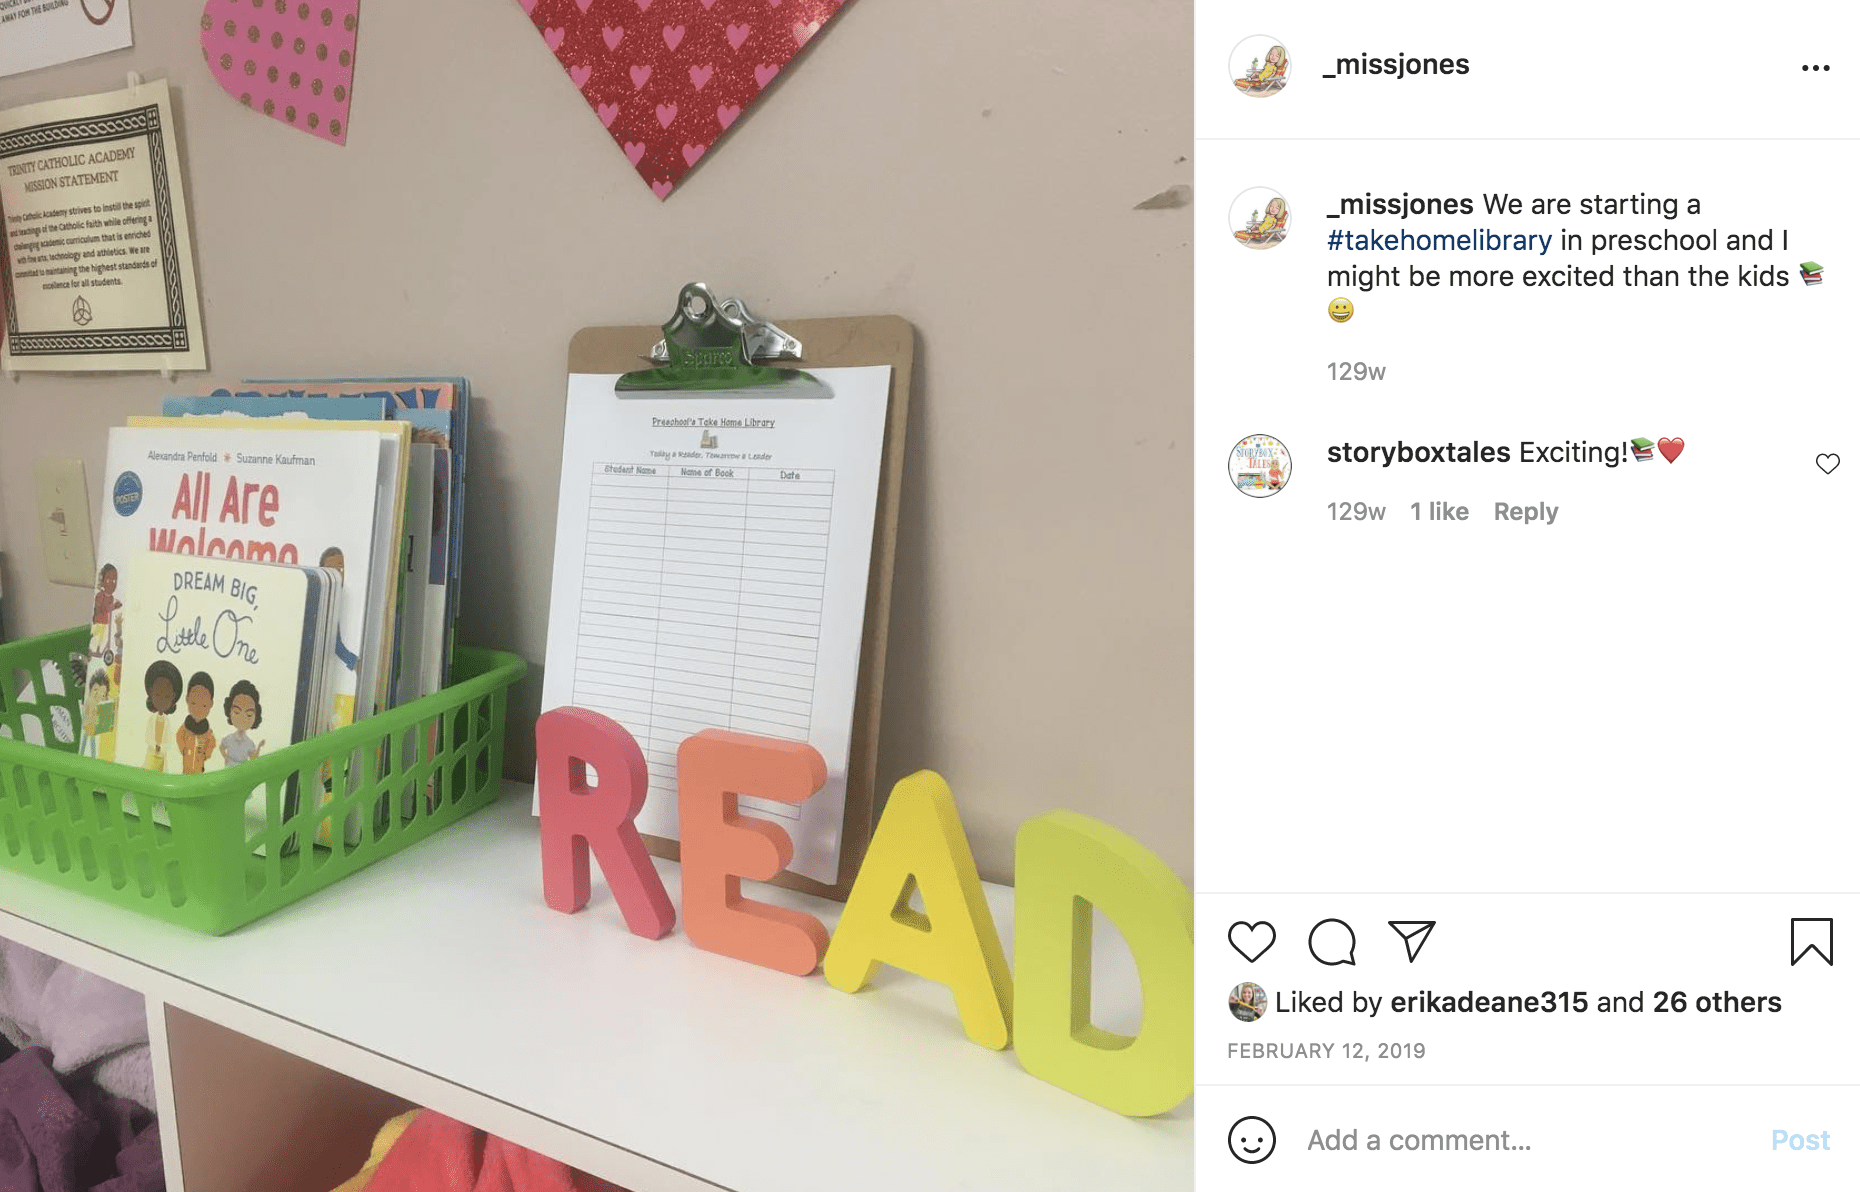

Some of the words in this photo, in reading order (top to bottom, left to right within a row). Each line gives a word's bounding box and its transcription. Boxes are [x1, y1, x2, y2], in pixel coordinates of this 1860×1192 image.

[31, 5, 42, 15] THE
[42, 0, 69, 12] BUILDING
[7, 161, 36, 177] TRINITY
[38, 154, 85, 171] CATHOLIC
[88, 147, 136, 165] ACADEMY
[24, 177, 58, 193] MISSION
[59, 170, 119, 188] STATEMENT
[23, 210, 42, 221] Catholic
[43, 208, 67, 218] Academy
[69, 206, 92, 215] strives
[93, 204, 101, 213] to
[103, 201, 121, 212] instill
[123, 201, 133, 210] the
[134, 198, 151, 210] spirit
[19, 226, 41, 237] teachings
[42, 224, 47, 233] of
[48, 224, 58, 232] the
[59, 221, 85, 231] Catholic
[86, 219, 102, 229] faith
[103, 216, 121, 227] while
[123, 215, 147, 226] offering
[14, 242, 39, 252] challenging
[41, 239, 65, 248] academic
[66, 235, 100, 245] curriculum
[101, 233, 115, 242] that
[116, 232, 123, 241] is
[124, 230, 151, 240] enriched
[17, 256, 26, 264] with
[27, 255, 36, 263] fine
[49, 251, 81, 262] technology
[83, 248, 95, 258] and
[97, 247, 127, 257] athletics.
[128, 246, 139, 254] We
[140, 246, 150, 254] are
[39, 267, 45, 275] to
[46, 266, 78, 277] maintaining
[79, 265, 90, 273] the
[91, 263, 117, 275] highest
[119, 260, 149, 271] standards
[150, 258, 158, 268] of
[43, 281, 70, 290] excellence
[71, 279, 80, 289] for
[81, 278, 89, 288] all
[91, 276, 123, 287] students.
[685, 351, 733, 369] Sparco
[652, 417, 696, 427] Preschool's
[698, 417, 718, 427] Take
[720, 418, 742, 427] Home
[744, 418, 776, 429] Library
[148, 450, 185, 461] Alexandra
[187, 451, 217, 462] Penfold
[237, 453, 273, 465] Suzanne
[275, 454, 315, 466] Kaufman
[649, 450, 671, 461] Today
[604, 465, 634, 474] Student
[636, 466, 656, 475] Name
[680, 467, 702, 476] Name
[704, 468, 713, 477] of
[715, 468, 734, 477] Book
[780, 471, 800, 480] Date
[115, 492, 140, 504] POSTER
[172, 470, 210, 523] All
[219, 475, 279, 527] Are
[173, 571, 225, 593] DREAM
[231, 577, 259, 611] BIG,
[157, 595, 209, 654] Little
[213, 609, 259, 664] One
